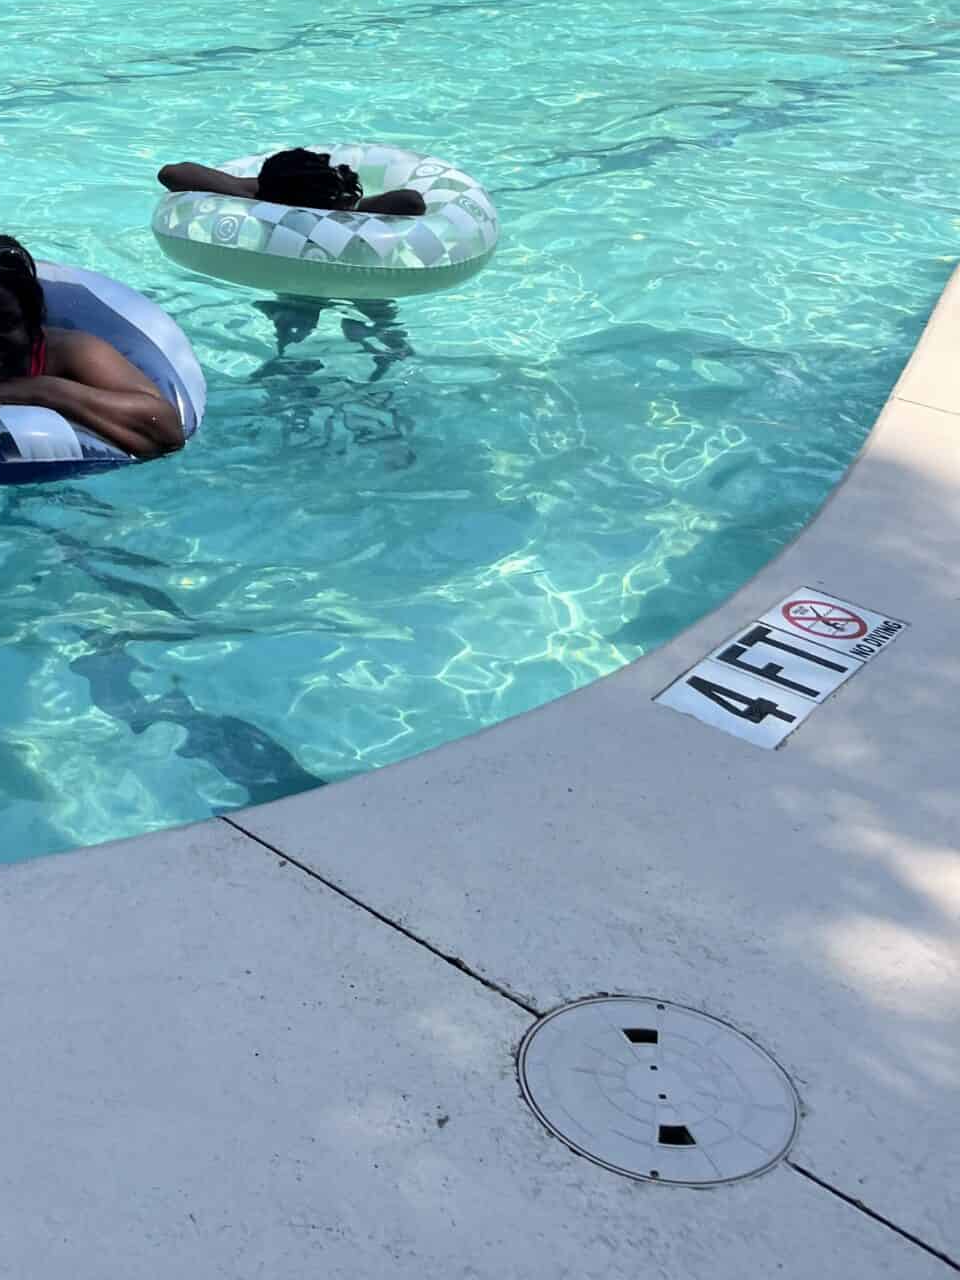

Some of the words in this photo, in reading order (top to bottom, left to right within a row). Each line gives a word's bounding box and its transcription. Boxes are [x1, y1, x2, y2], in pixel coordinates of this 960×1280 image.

[715, 624, 849, 699] FT
[849, 643, 875, 659] NO
[862, 620, 903, 648] DIVING
[685, 674, 798, 725] 4
